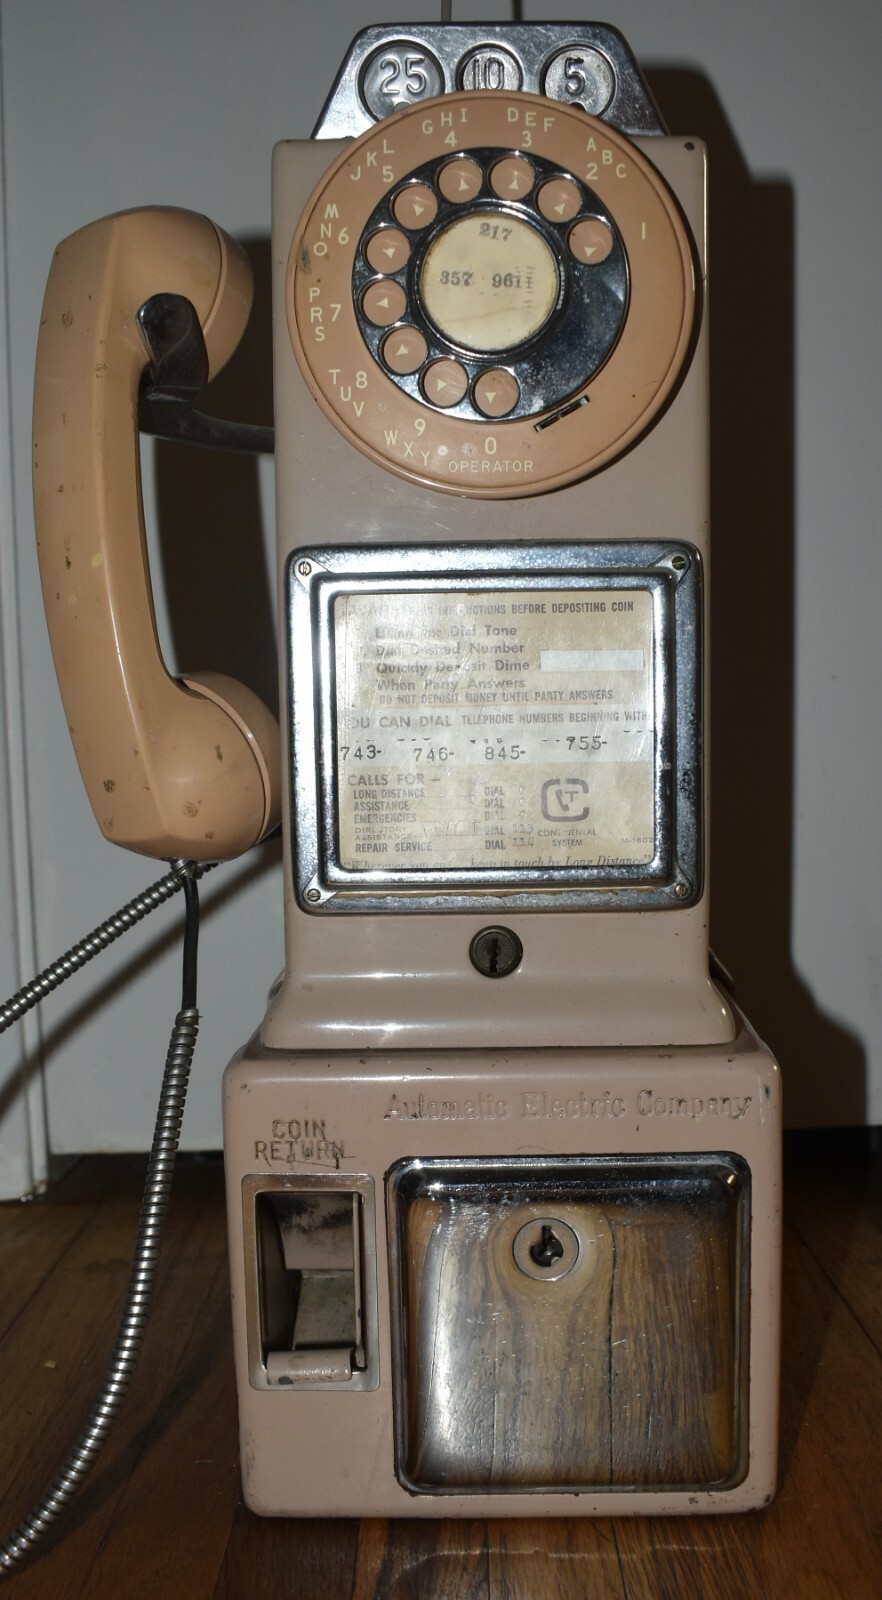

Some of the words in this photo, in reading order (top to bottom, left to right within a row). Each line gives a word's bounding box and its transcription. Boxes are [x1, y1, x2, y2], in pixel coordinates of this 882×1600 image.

[380, 56, 427, 94] 25
[473, 56, 505, 89] 10
[565, 57, 587, 95] 5
[443, 130, 458, 147] 4
[521, 130, 533, 147] 3
[382, 166, 395, 182] 5
[586, 163, 598, 180] 2
[338, 228, 350, 245] 6
[479, 223, 512, 240] 217
[440, 271, 473, 286] 357
[330, 304, 342, 322] 7
[355, 371, 368, 388] 8
[413, 419, 426, 436] 9
[448, 459, 534, 473] OPERATOR
[511, 604, 546, 614] BEFORE
[552, 602, 606, 613] DEPOSITING
[611, 601, 634, 612] COIN
[450, 624, 476, 637] Dial
[484, 624, 517, 636] Tone
[470, 642, 525, 654] Number
[376, 662, 427, 676] Quickly
[495, 660, 530, 671] Dime
[376, 677, 415, 690] When
[424, 677, 458, 691] Party
[467, 677, 526, 690] Answers
[380, 695, 392, 704] DO
[396, 695, 417, 704] NOT
[421, 694, 459, 704] DEPOSIT
[465, 693, 497, 703] MONEY
[503, 692, 529, 702] UNTIL
[535, 691, 564, 701] PARTY
[569, 690, 613, 700] ANSWERS
[379, 716, 411, 728] CAN
[420, 716, 452, 727] DIAL
[461, 714, 514, 725] TELEPHONE
[519, 713, 564, 723] NUMBERS
[569, 711, 619, 722] BEGINNING
[347, 774, 389, 786] CALLS
[397, 773, 425, 785] FOR
[353, 789, 377, 799] LONG
[381, 788, 426, 799] DISTANCE
[484, 786, 505, 796] DIAL
[354, 801, 410, 812] ASSISTANCE
[484, 798, 505, 809] DIAL
[354, 813, 417, 824] EMERGENCIES
[355, 833, 413, 841] ASSISTANCE
[537, 828, 597, 837] CONNENTAL
[355, 842, 388, 853] REPAIR
[394, 841, 432, 851] SERVICE
[485, 839, 506, 850] DIAL
[551, 839, 583, 848] SYSTEM
[382, 1092, 509, 1121] Automatic
[521, 1090, 627, 1120] Electric
[637, 1088, 753, 1120] Company
[272, 1119, 326, 1140] COIN
[254, 1140, 345, 1161] RETURN
